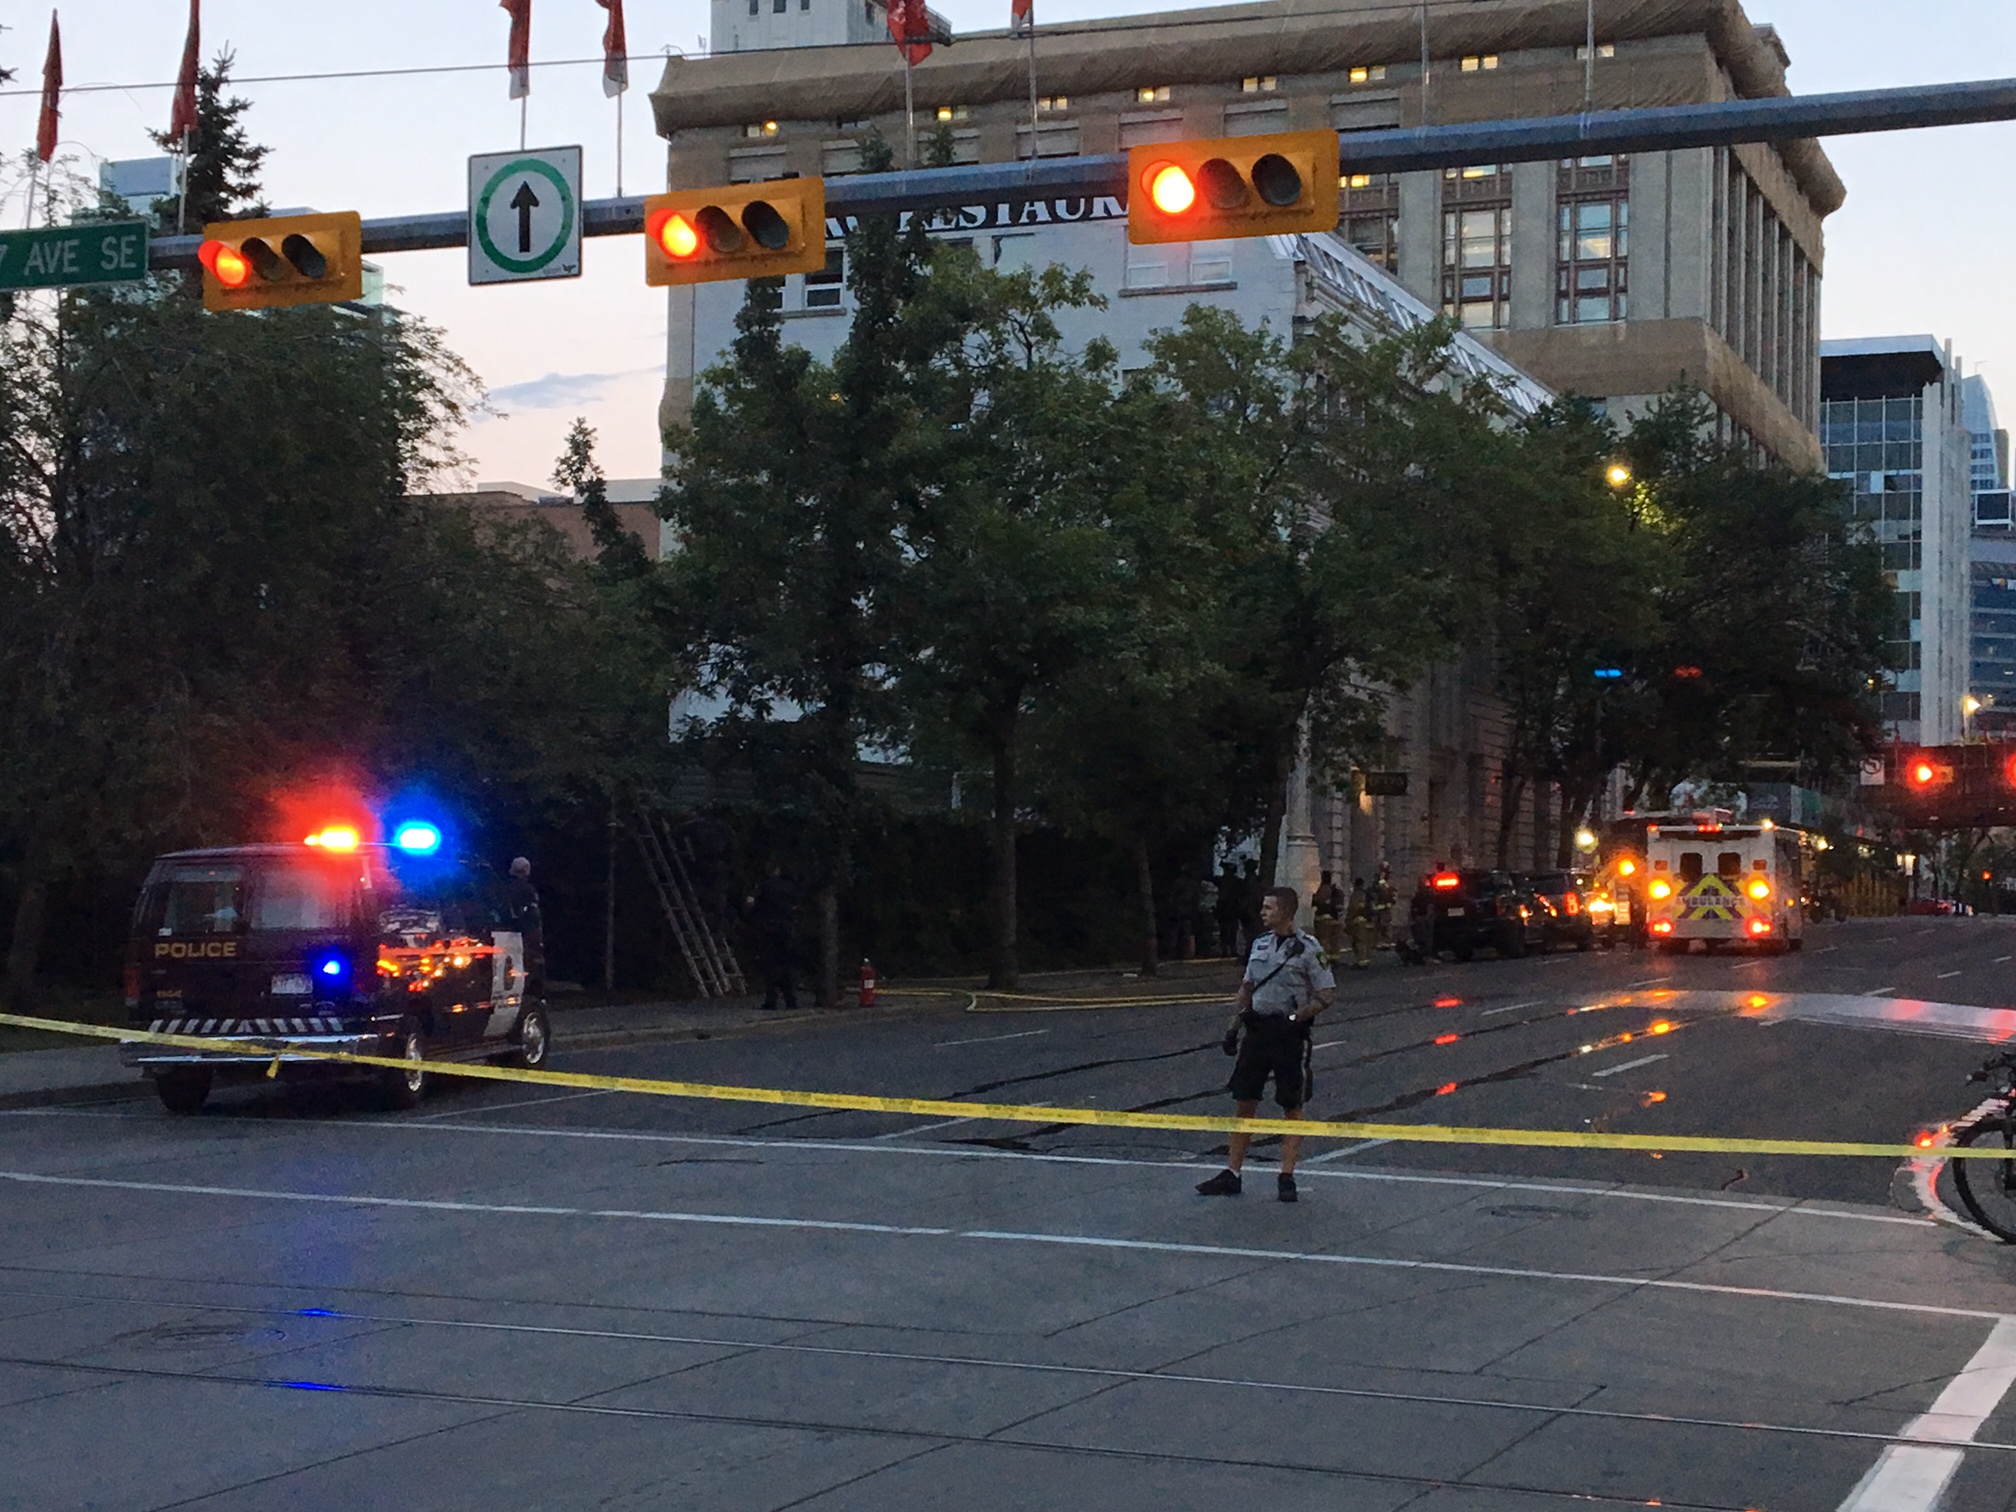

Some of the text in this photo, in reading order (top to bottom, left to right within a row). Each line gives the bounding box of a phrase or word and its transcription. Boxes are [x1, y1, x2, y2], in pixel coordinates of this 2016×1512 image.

[23, 239, 80, 276] AVE
[100, 234, 137, 270] SE
[154, 941, 237, 959] POLICE
